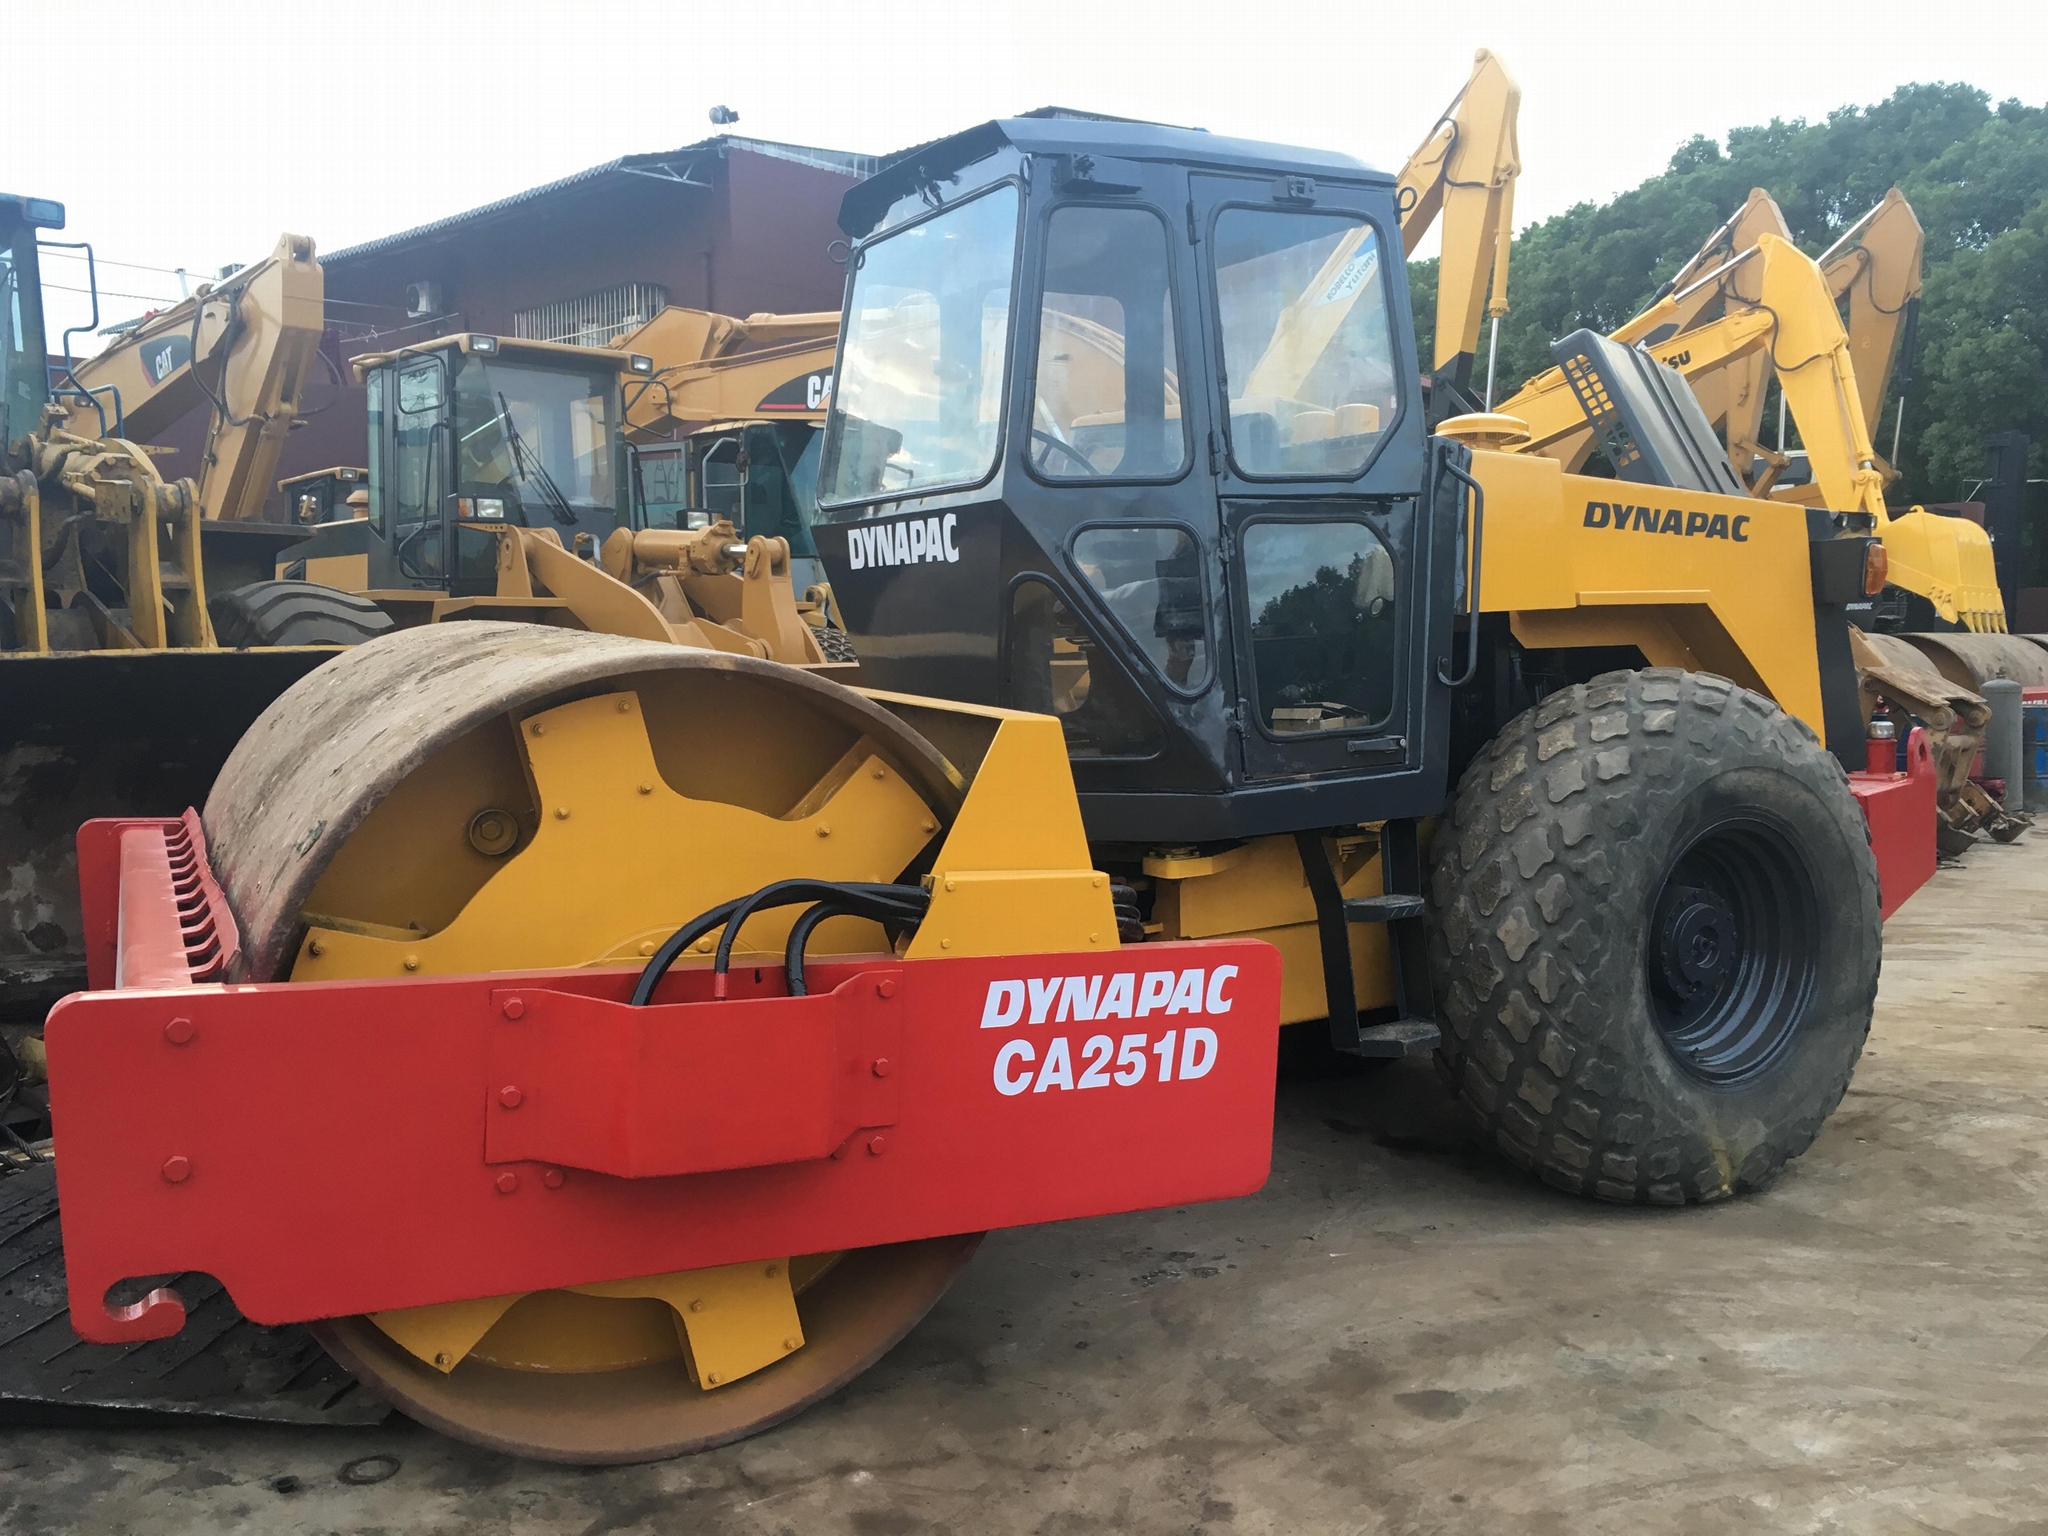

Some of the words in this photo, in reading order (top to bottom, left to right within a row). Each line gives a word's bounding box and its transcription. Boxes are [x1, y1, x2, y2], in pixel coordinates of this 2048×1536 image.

[155, 345, 173, 380] CAT
[847, 513, 960, 570] DYNAPAC
[1582, 501, 1751, 542] DYNAPAC
[1845, 602, 1873, 611] DYNAPAC
[979, 964, 1239, 1029] DYNAPAC
[992, 1027, 1218, 1096] CA251D
